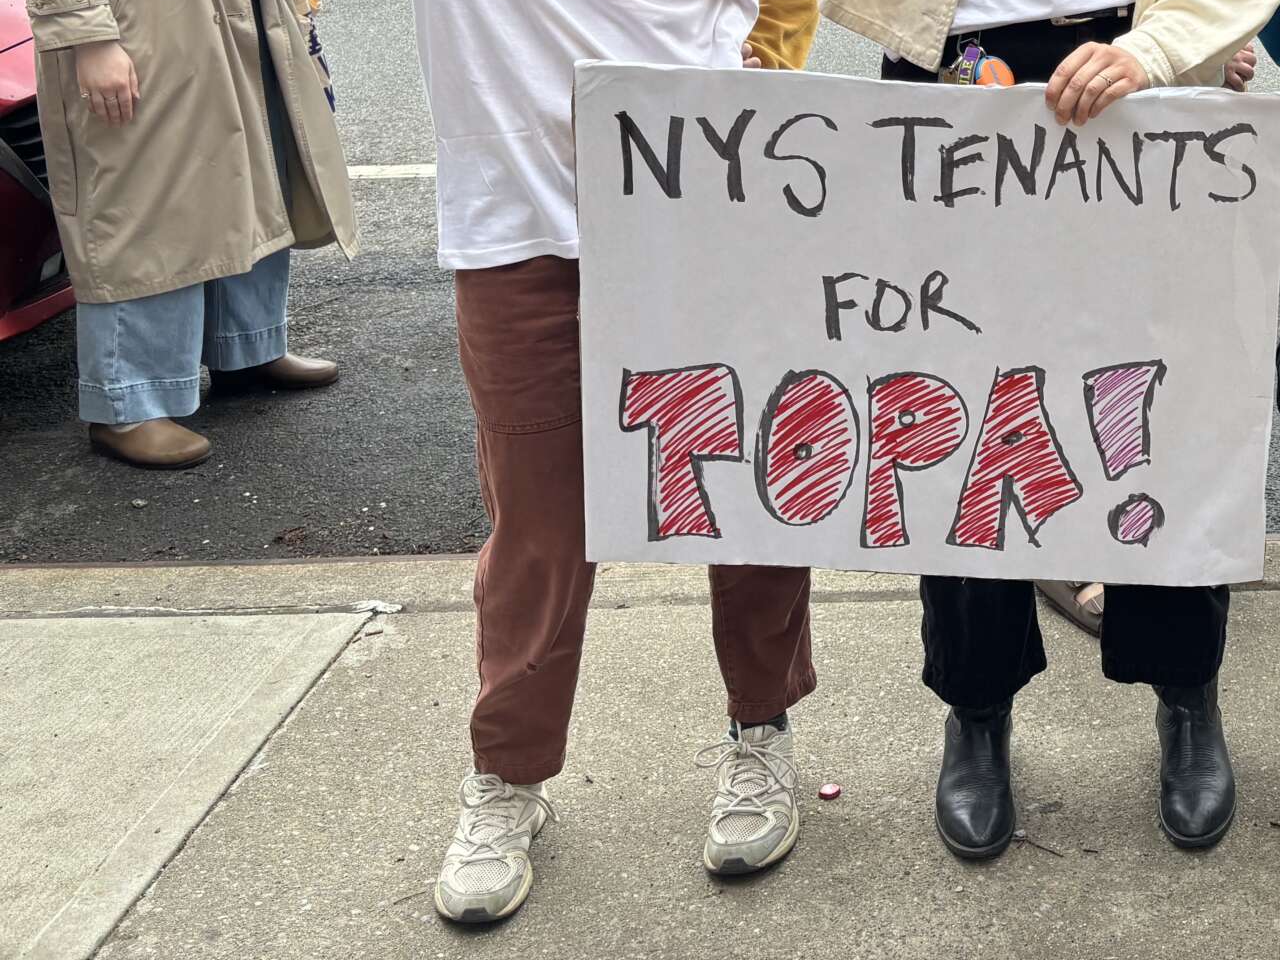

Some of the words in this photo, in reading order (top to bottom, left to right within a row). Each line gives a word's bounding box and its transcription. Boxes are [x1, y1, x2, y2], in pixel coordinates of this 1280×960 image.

[614, 108, 838, 217] NYS
[865, 117, 1258, 212] TENANTS
[821, 269, 983, 341] FOR
[618, 359, 1167, 550] TOPA!
